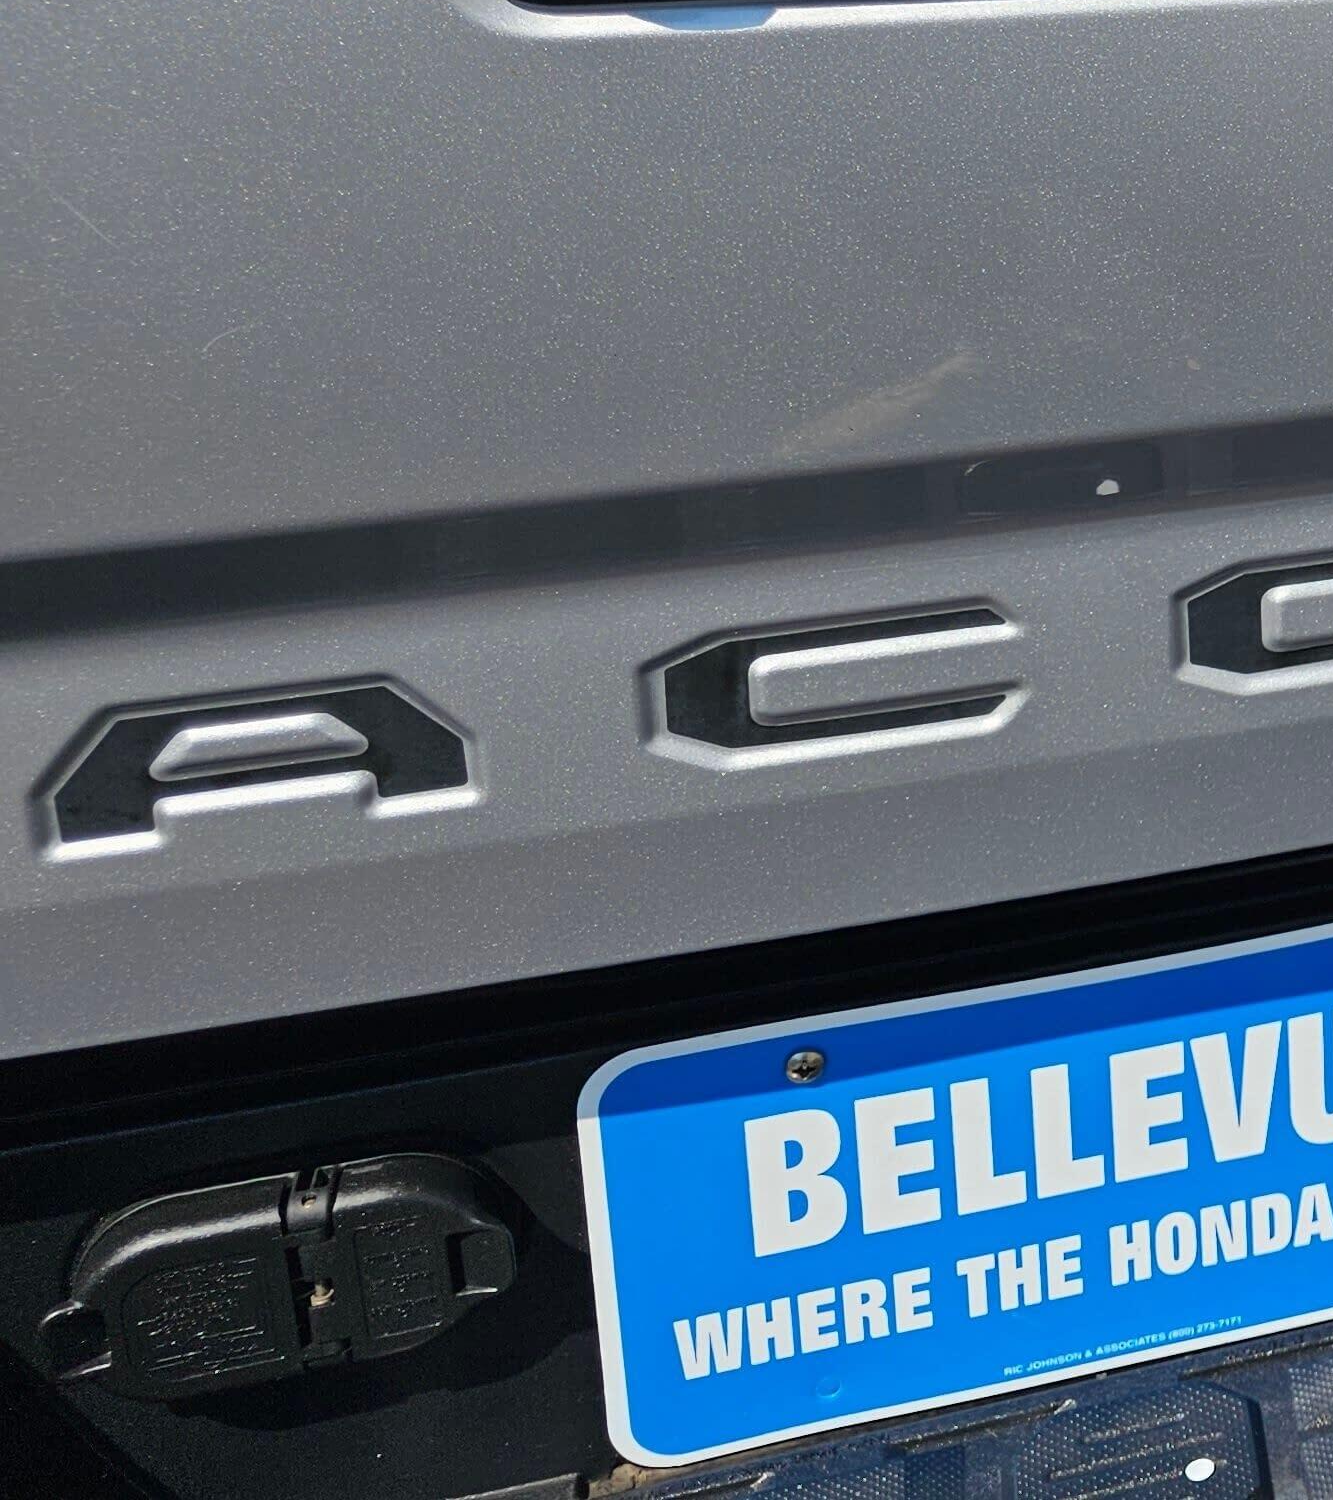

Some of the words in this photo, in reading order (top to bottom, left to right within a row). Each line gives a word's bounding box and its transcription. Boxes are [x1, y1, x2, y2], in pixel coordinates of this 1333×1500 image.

[673, 1267, 933, 1380] WHERE
[956, 1234, 1084, 1318] THE
[1004, 1365, 1024, 1376] RIC
[1026, 1352, 1083, 1372] JOHNSON
[1084, 1349, 1093, 1359] &
[1096, 1331, 1166, 1356] ASSOCIATES
